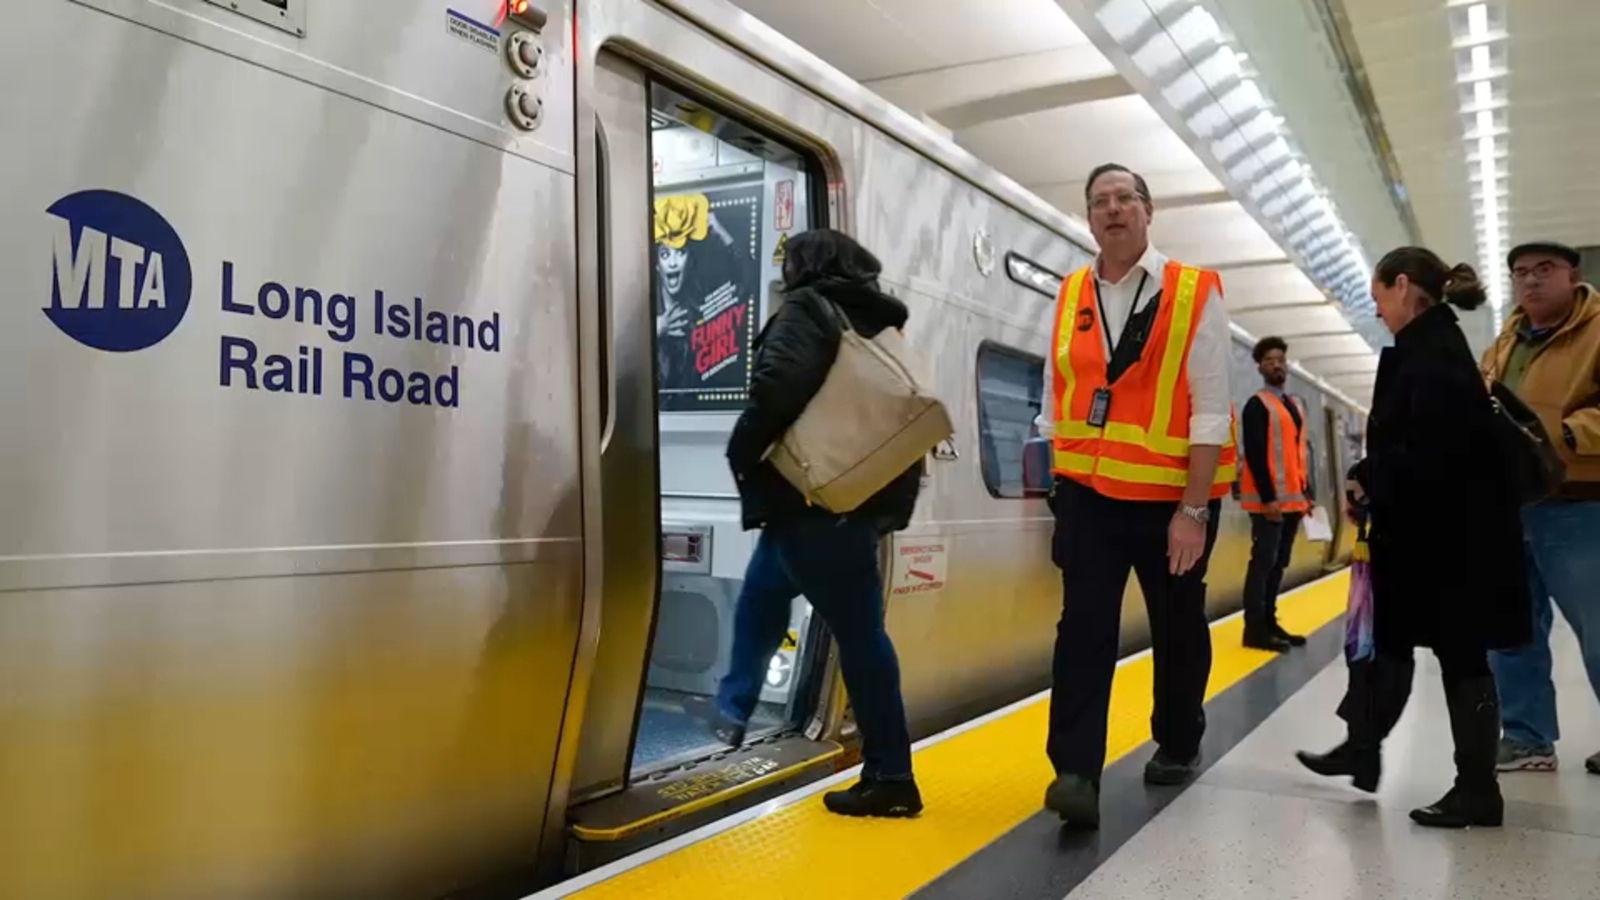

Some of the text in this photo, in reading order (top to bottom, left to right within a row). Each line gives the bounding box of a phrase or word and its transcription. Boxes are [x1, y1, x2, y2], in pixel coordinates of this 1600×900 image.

[450, 17, 498, 44] DOOR DISABLED
[450, 26, 498, 52] WHEN FLASHING
[46, 211, 166, 309] MTA
[220, 261, 500, 352] Long Island
[691, 303, 747, 351] FUNNY
[219, 335, 459, 407] Rail Road
[695, 329, 740, 374] GIRL
